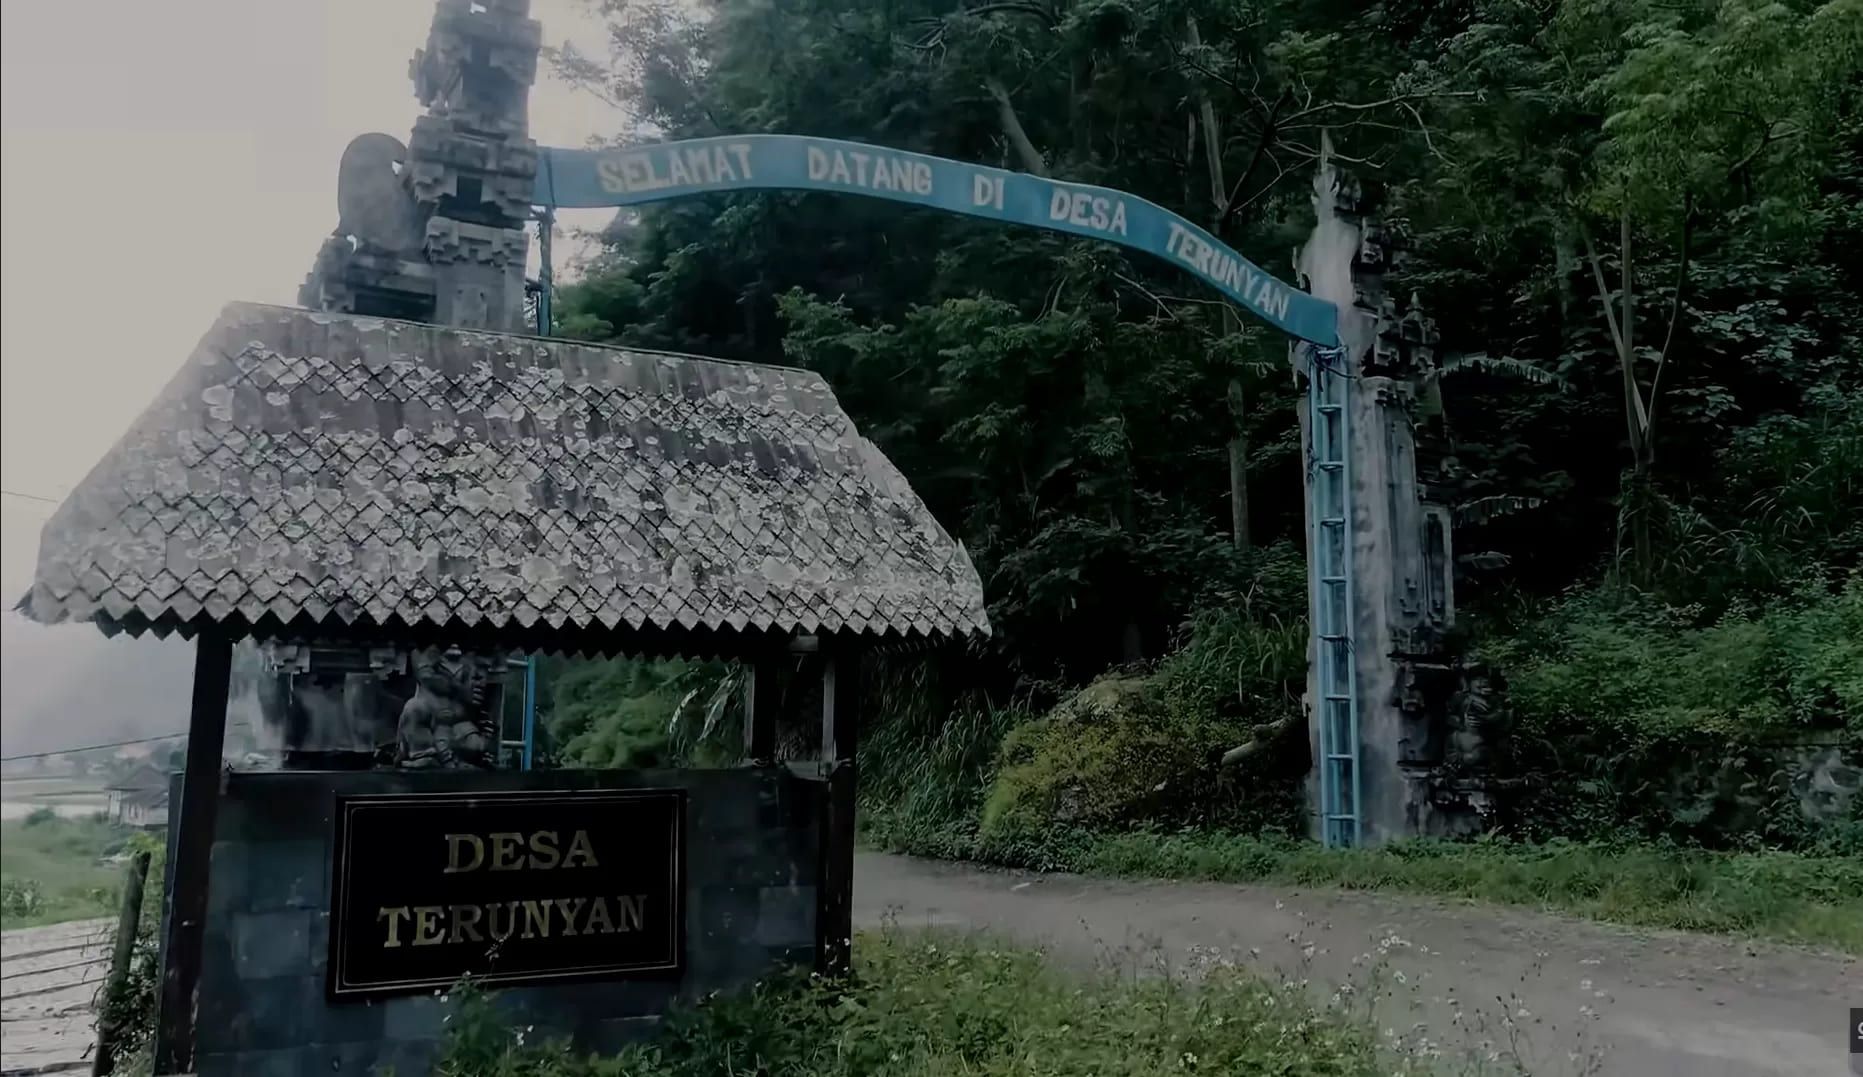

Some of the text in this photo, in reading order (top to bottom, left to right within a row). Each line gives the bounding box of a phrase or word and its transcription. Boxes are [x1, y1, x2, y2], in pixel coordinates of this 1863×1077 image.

[597, 144, 1290, 321] SELAMAT DATANG DI DESA TERUNYAN
[443, 829, 599, 874] DESA
[377, 894, 649, 948] TERUNYAN
